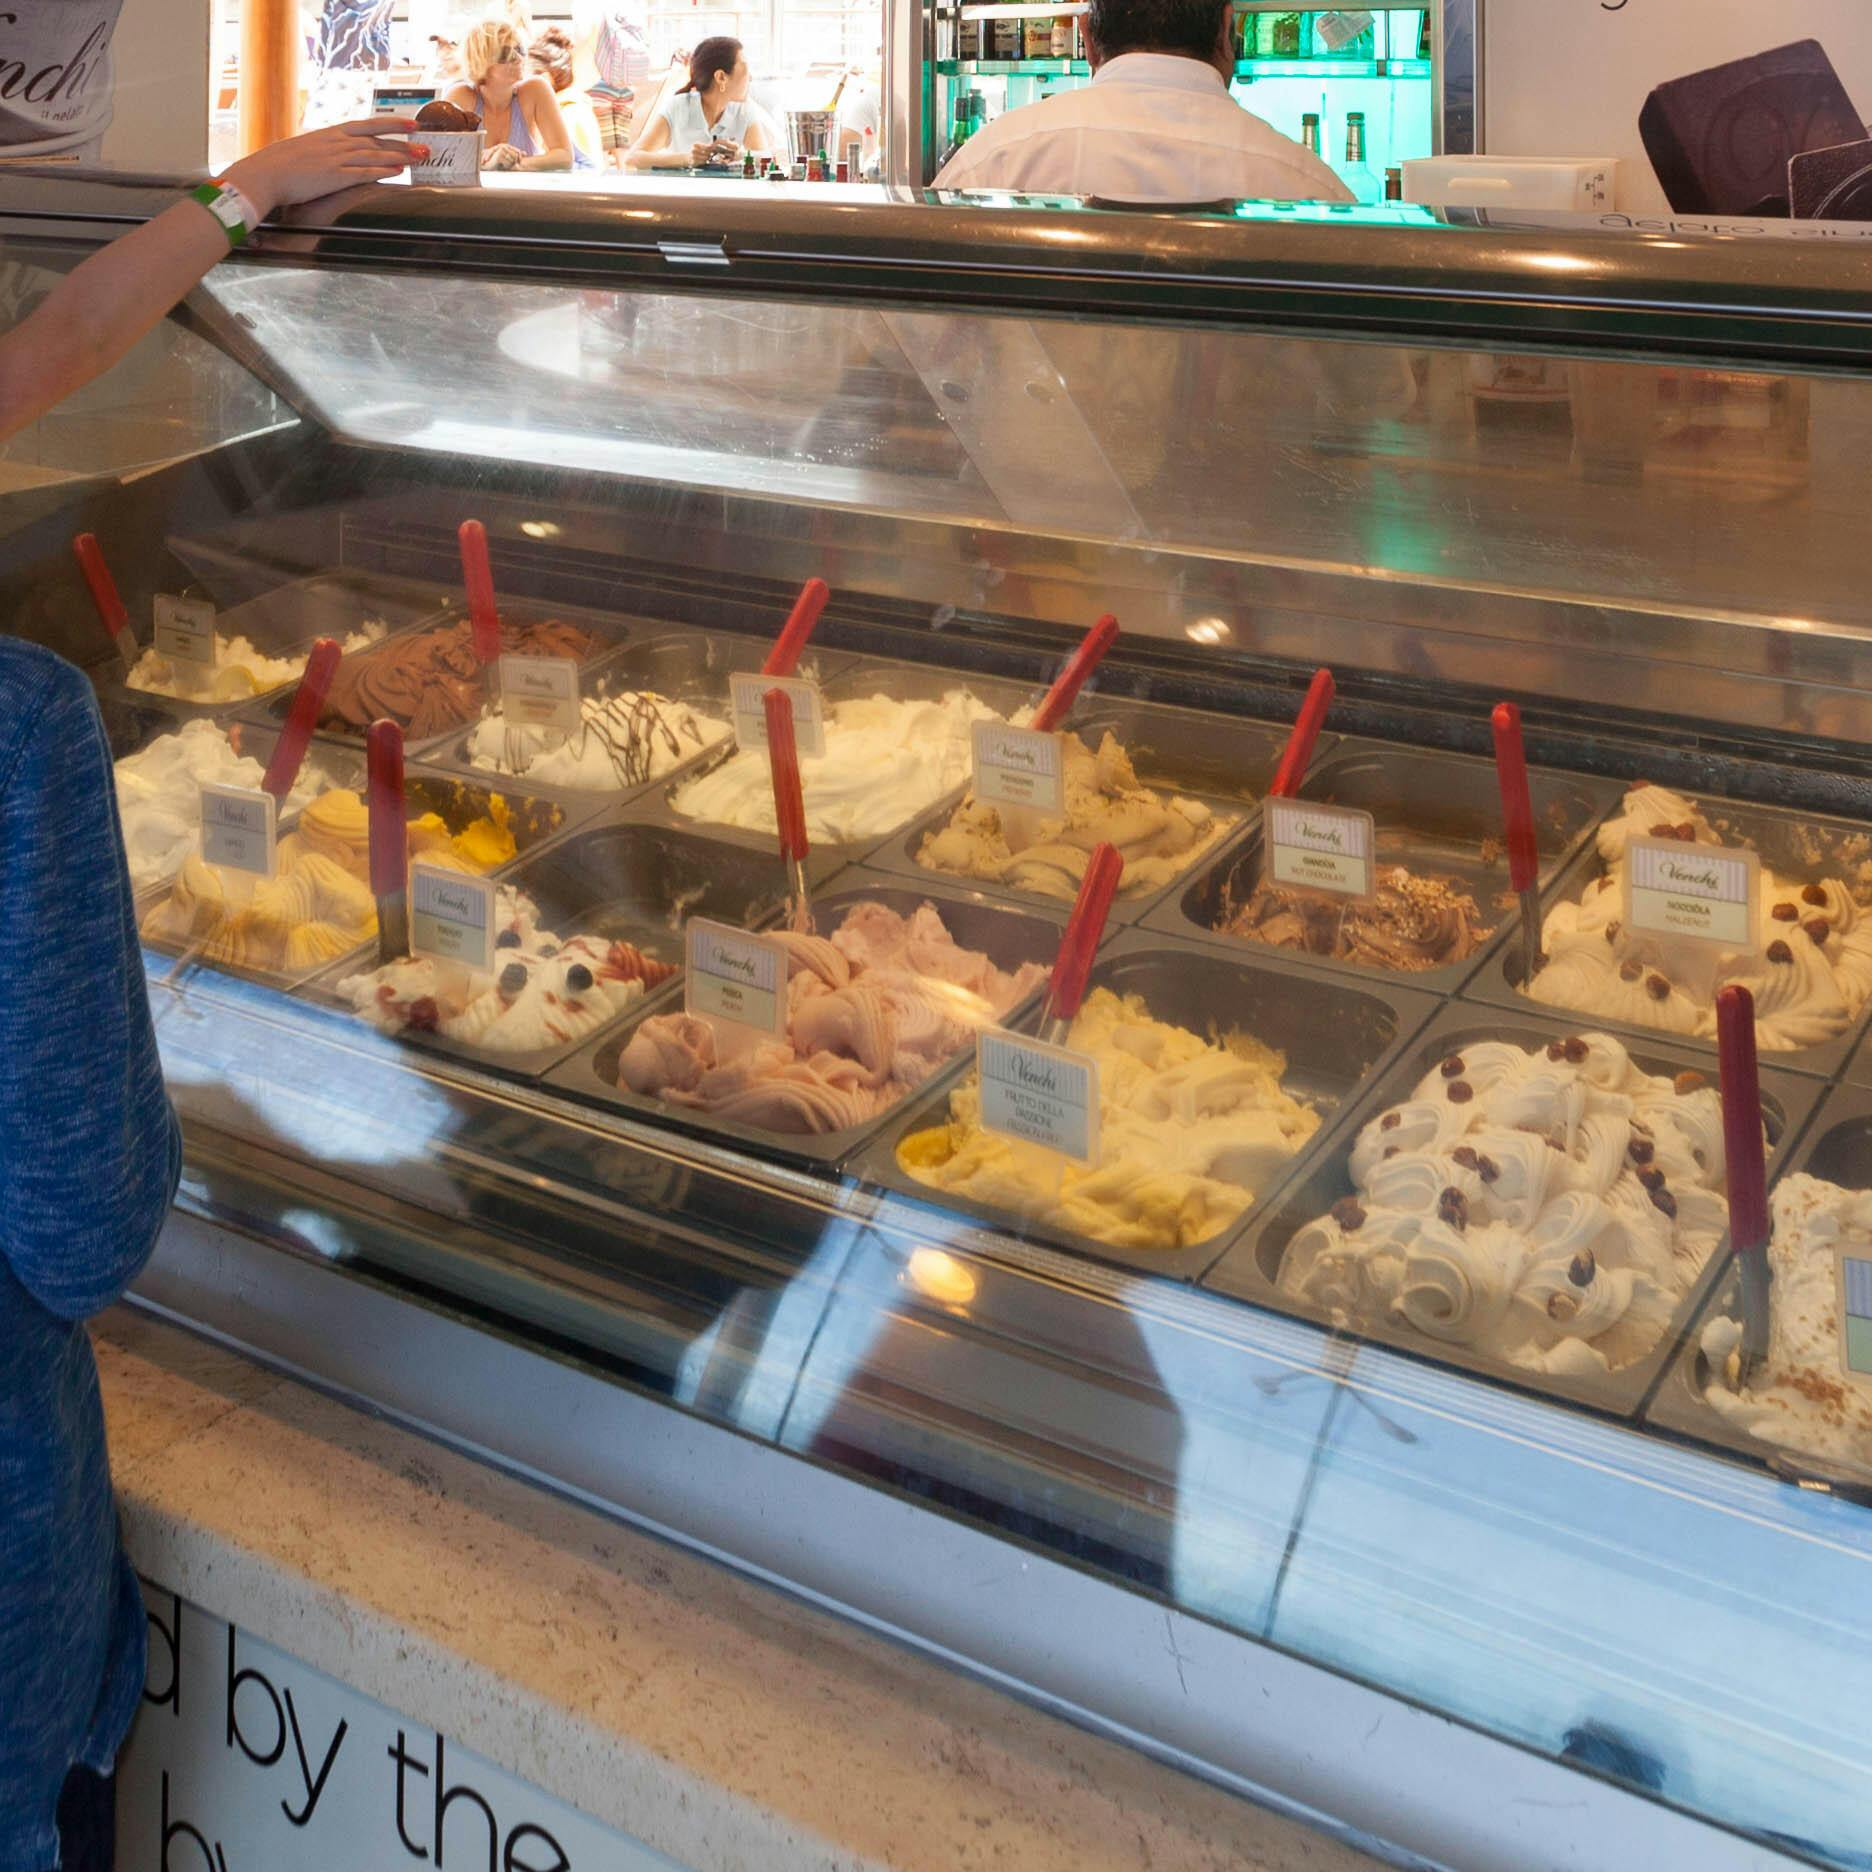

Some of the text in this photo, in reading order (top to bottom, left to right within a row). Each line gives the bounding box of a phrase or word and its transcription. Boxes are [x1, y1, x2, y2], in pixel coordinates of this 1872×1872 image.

[1294, 821, 1343, 847] Venchi
[1658, 862, 1719, 890] Venchi
[1010, 1052, 1056, 1091] Venchi
[227, 1622, 349, 1827] by
[387, 1730, 572, 1872] the
